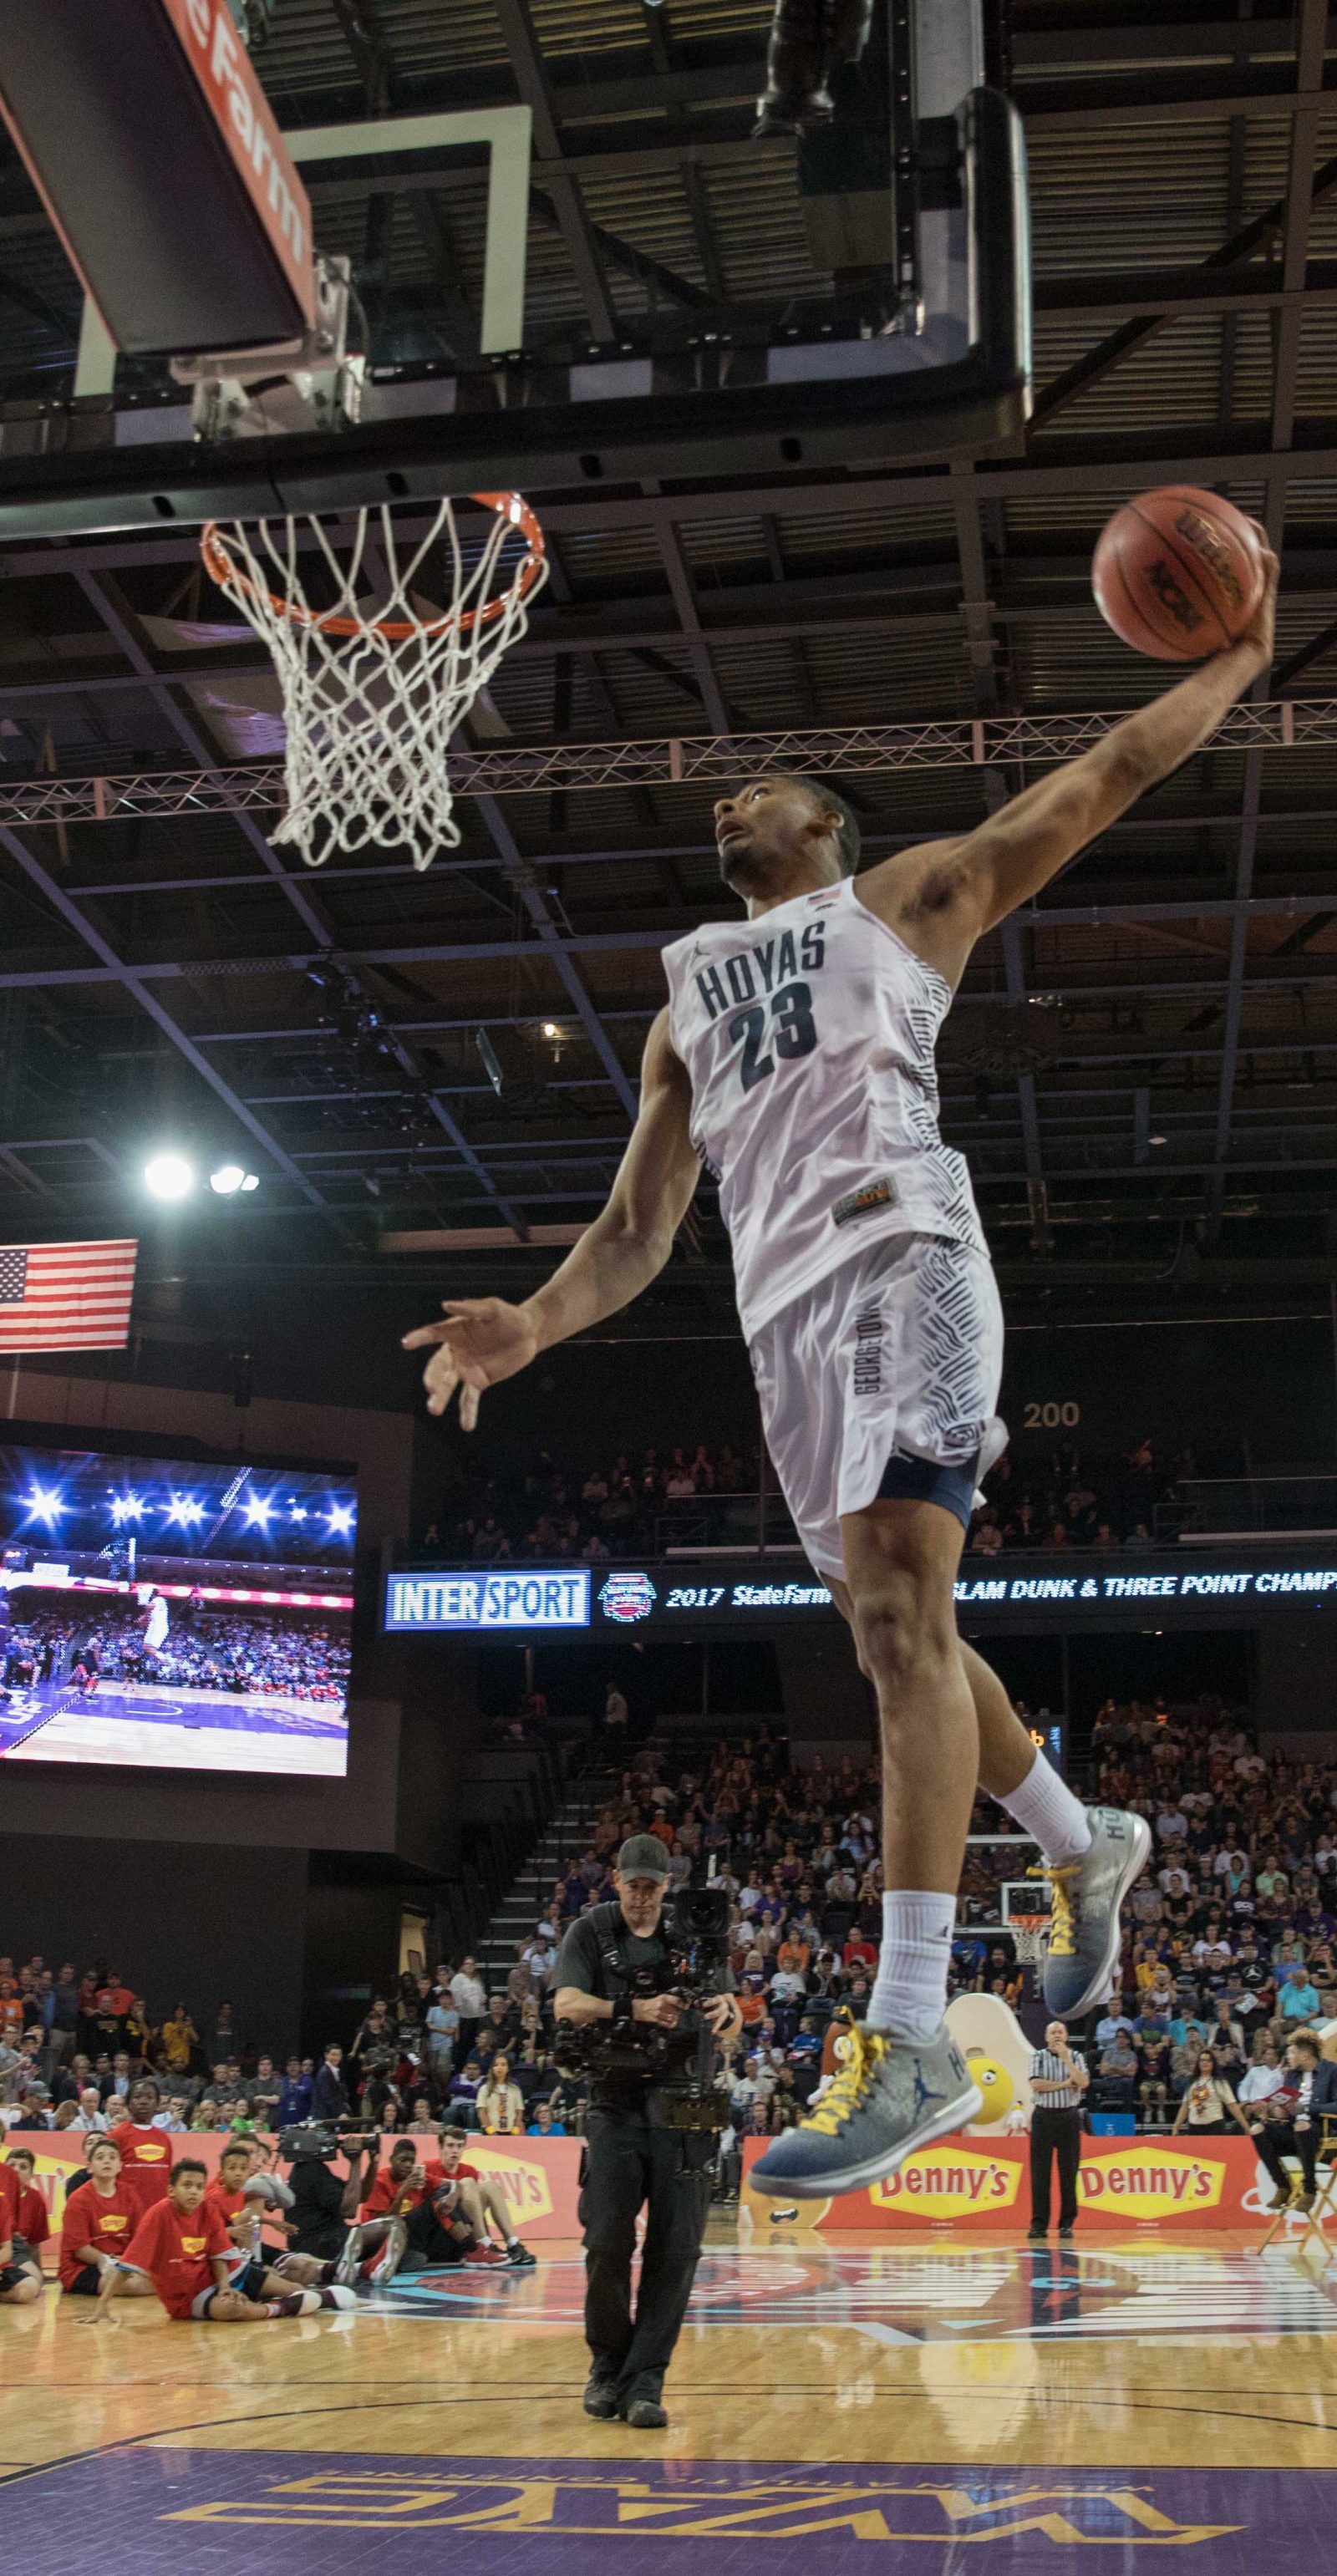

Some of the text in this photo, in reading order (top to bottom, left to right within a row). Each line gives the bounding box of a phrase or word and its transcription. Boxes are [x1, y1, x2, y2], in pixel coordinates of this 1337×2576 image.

[695, 920, 826, 1021] HOYAS
[728, 982, 817, 1095] 23
[853, 1307, 883, 1396] GEORGETOW
[1024, 1402, 1080, 1427] 200
[666, 1588, 725, 1607] 2017
[1009, 1579, 1077, 1599] DUNK
[1079, 1579, 1098, 1598] &
[1103, 1576, 1178, 1597] THREE
[1181, 1574, 1253, 1595] POINT
[1254, 1571, 1337, 1592] CHAMP
[880, 2163, 1009, 2200] Denny's
[1078, 2163, 1213, 2200] Denny's
[313, 2470, 638, 2483] CONFERENCE
[654, 2477, 902, 2488] ATHLETIC
[916, 2482, 1156, 2492] WESTERN
[153, 2476, 1249, 2544] WAC
